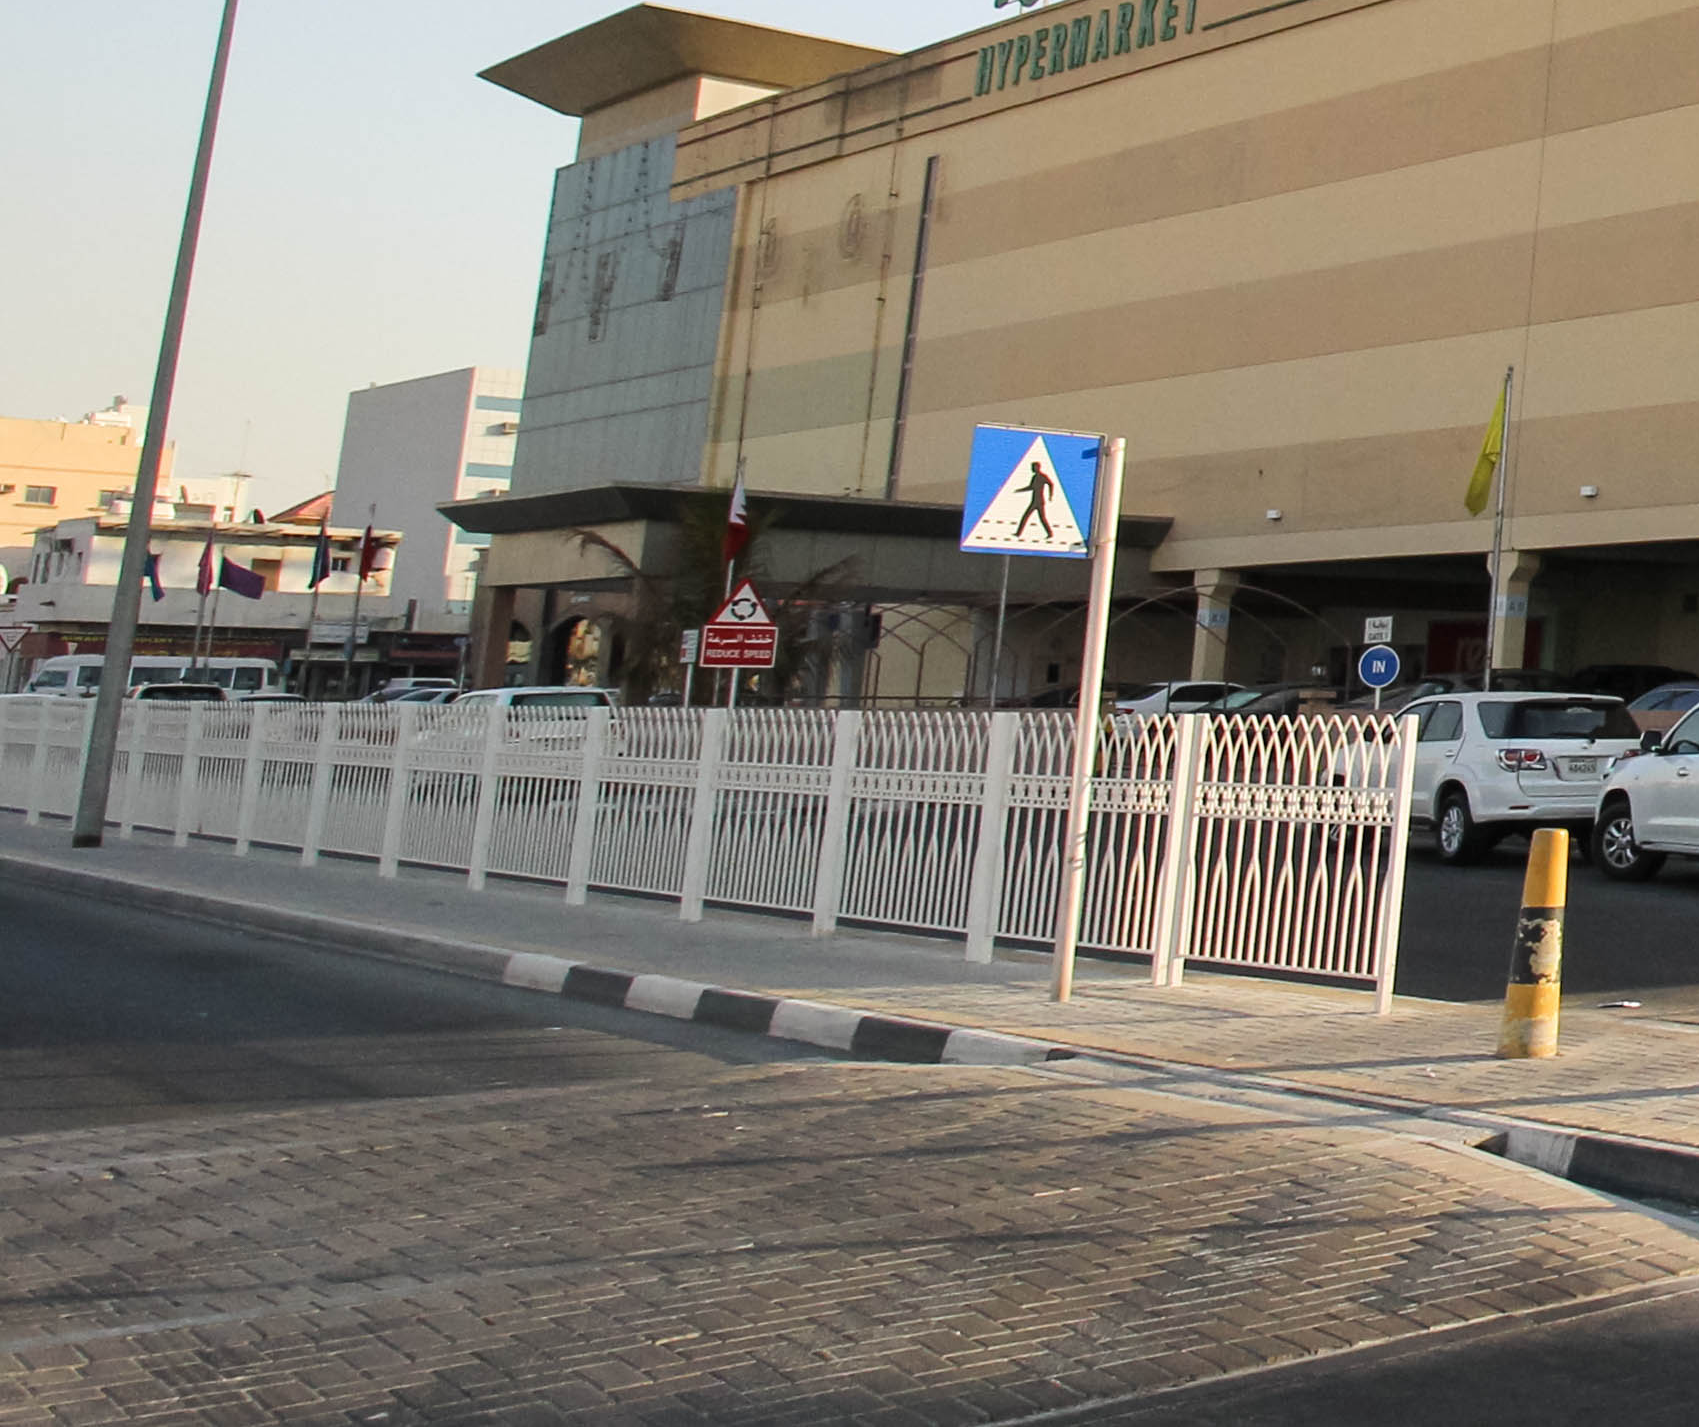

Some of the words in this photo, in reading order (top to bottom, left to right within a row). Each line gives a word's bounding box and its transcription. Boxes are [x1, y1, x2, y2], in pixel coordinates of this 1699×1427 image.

[706, 648, 741, 659] REDUCE
[743, 649, 772, 659] SPEED
[1372, 660, 1386, 674] IN
